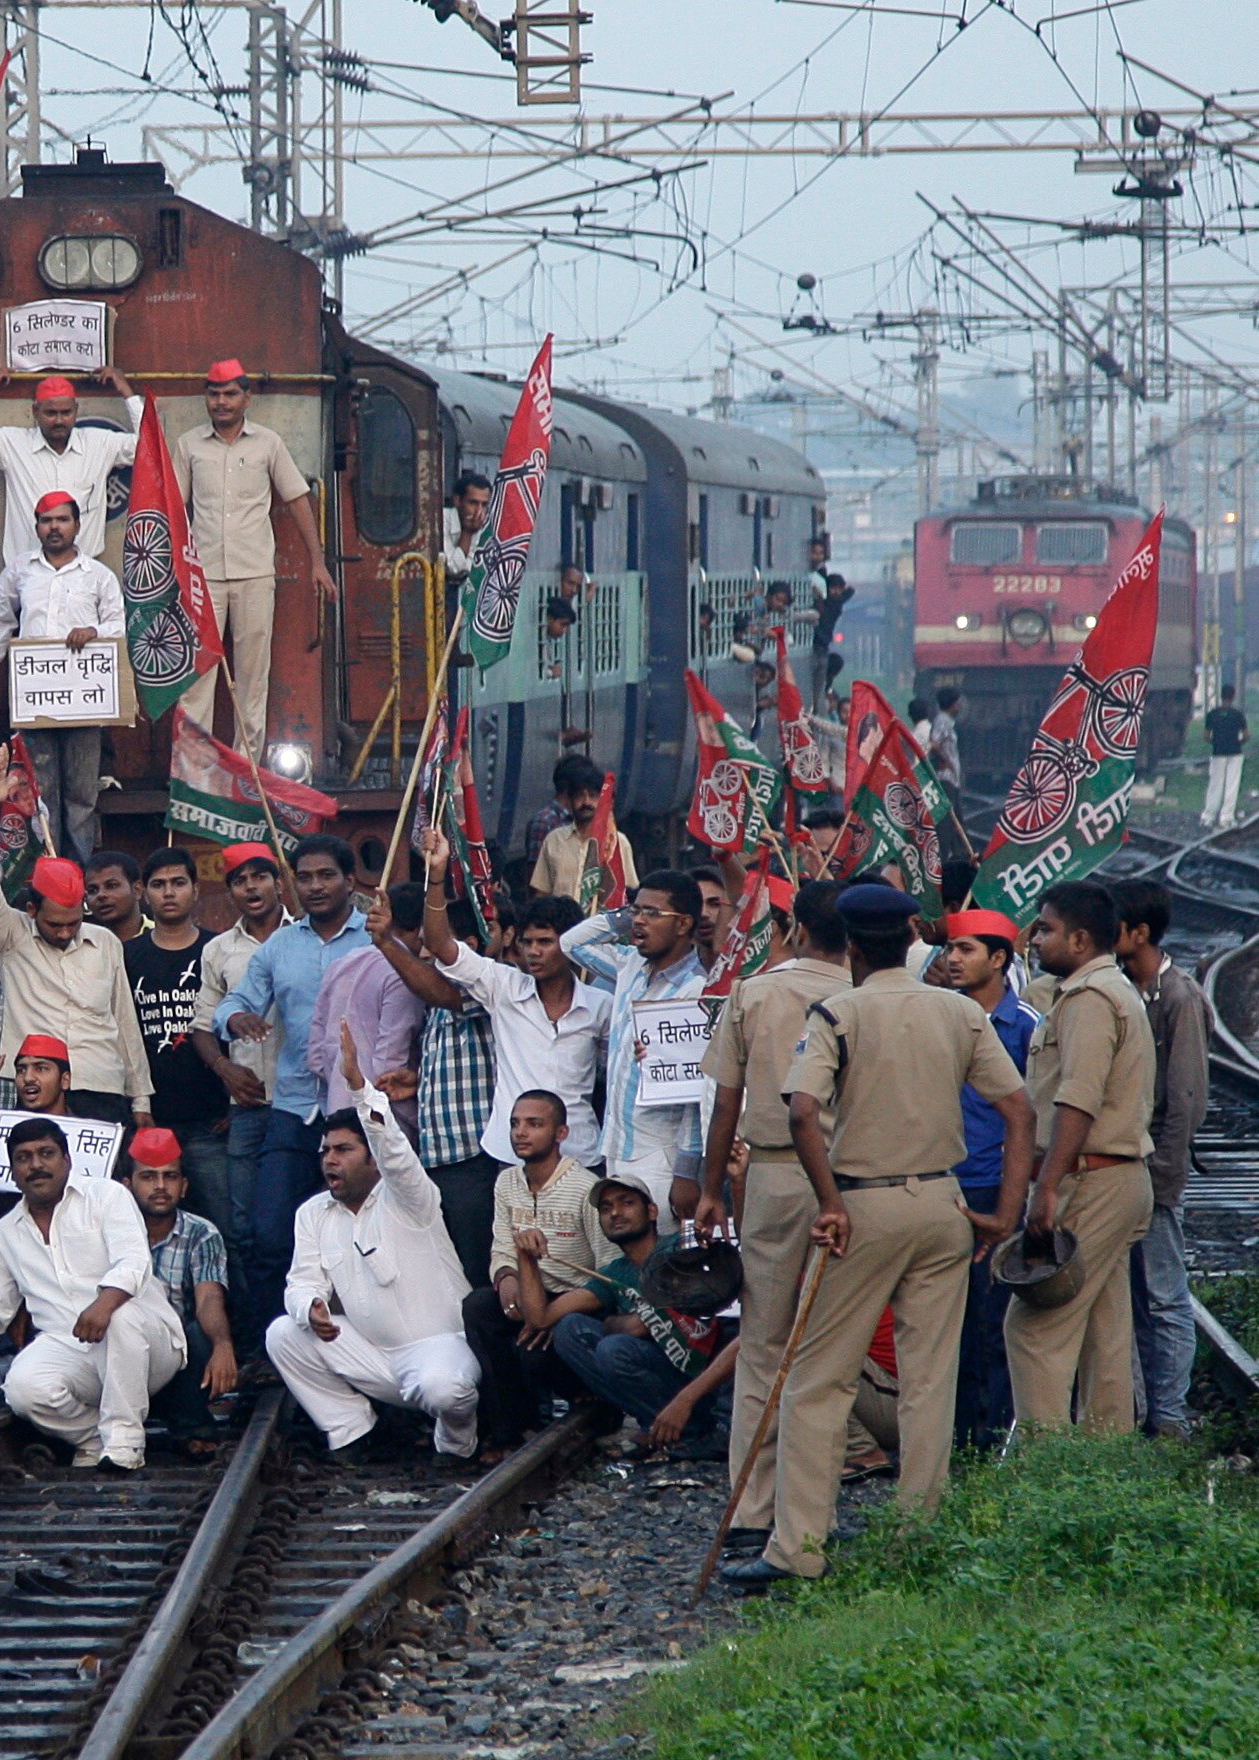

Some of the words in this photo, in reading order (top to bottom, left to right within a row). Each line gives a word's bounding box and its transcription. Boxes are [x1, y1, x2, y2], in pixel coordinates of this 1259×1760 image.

[13, 321, 21, 333] 6
[27, 311, 76, 331] सिलेण्डर
[82, 316, 99, 331] का
[17, 340, 40, 357] कोटा
[16, 656, 68, 675] डीजल
[77, 654, 112, 680] वृद्धि
[25, 689, 73, 706] वापस
[82, 683, 105, 703] लो
[159, 990, 169, 1002] In
[172, 989, 201, 1001] Oakla
[141, 1008, 160, 1020] Love
[163, 1005, 173, 1017] In
[144, 1023, 162, 1035] Love
[641, 1029, 650, 1045] 6
[658, 1019, 715, 1044] सिलेण्ड
[650, 1059, 677, 1082] कोटा
[76, 1129, 114, 1156] सिंह
